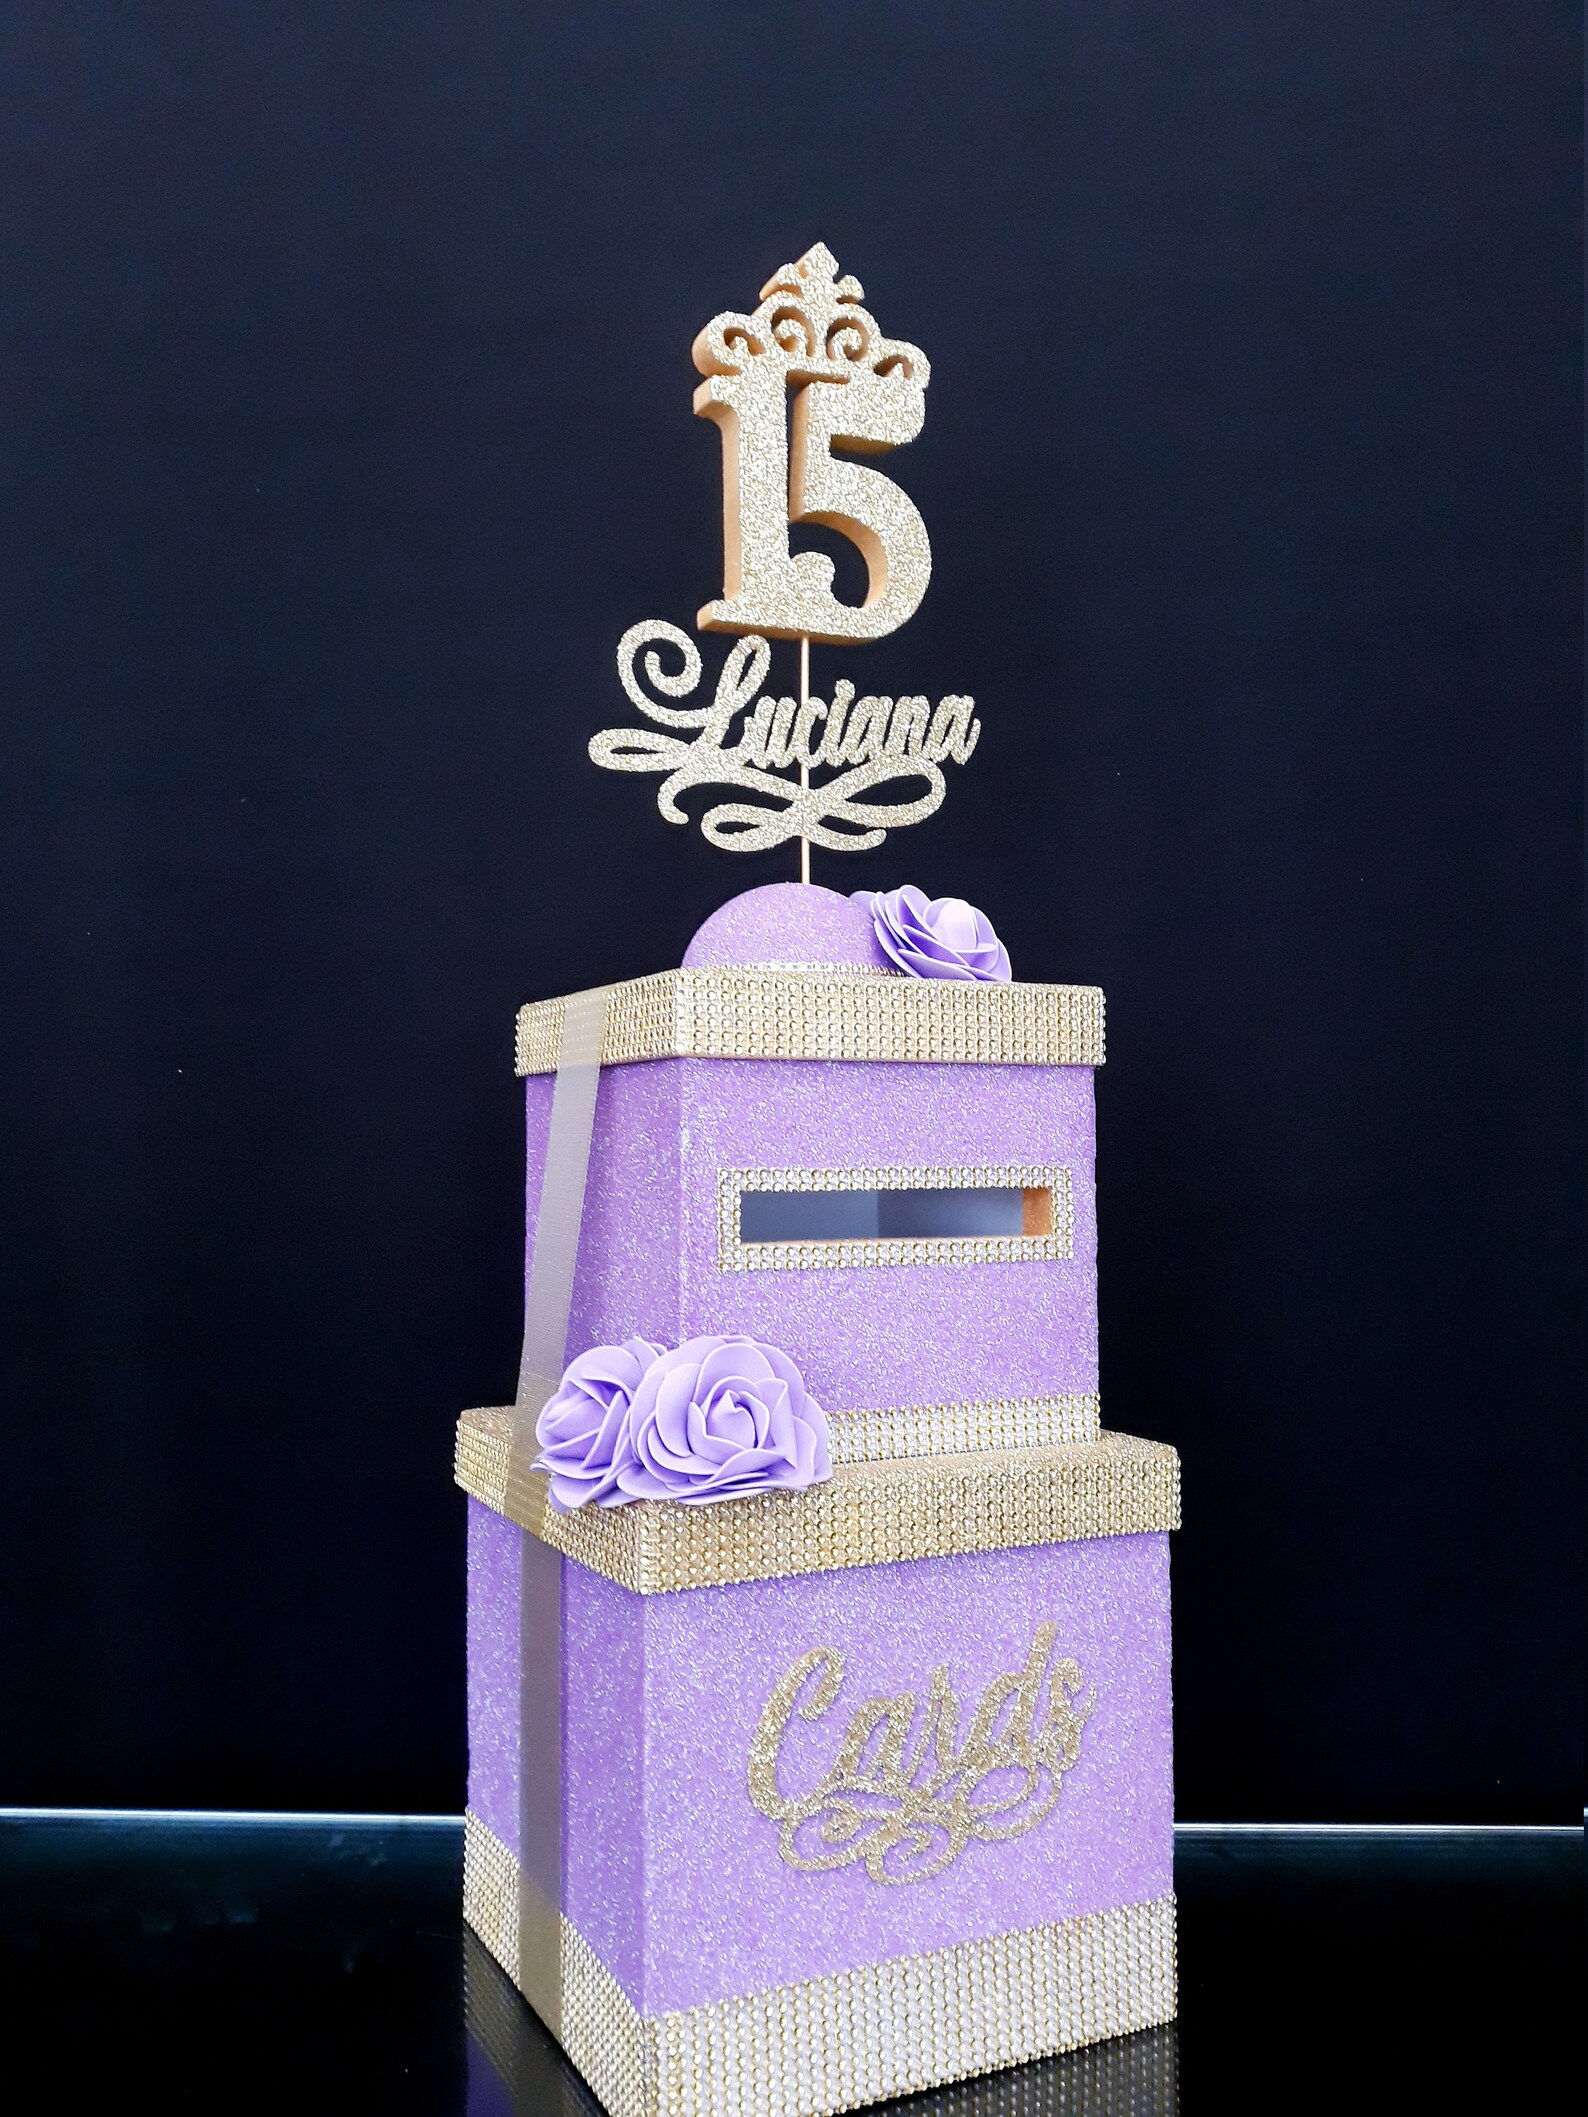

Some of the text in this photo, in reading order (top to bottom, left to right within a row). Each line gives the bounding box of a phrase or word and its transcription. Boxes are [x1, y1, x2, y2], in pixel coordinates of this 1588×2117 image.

[693, 366, 934, 646] 15
[588, 618, 981, 790] Luciana
[747, 1619, 1098, 1840] Cards
